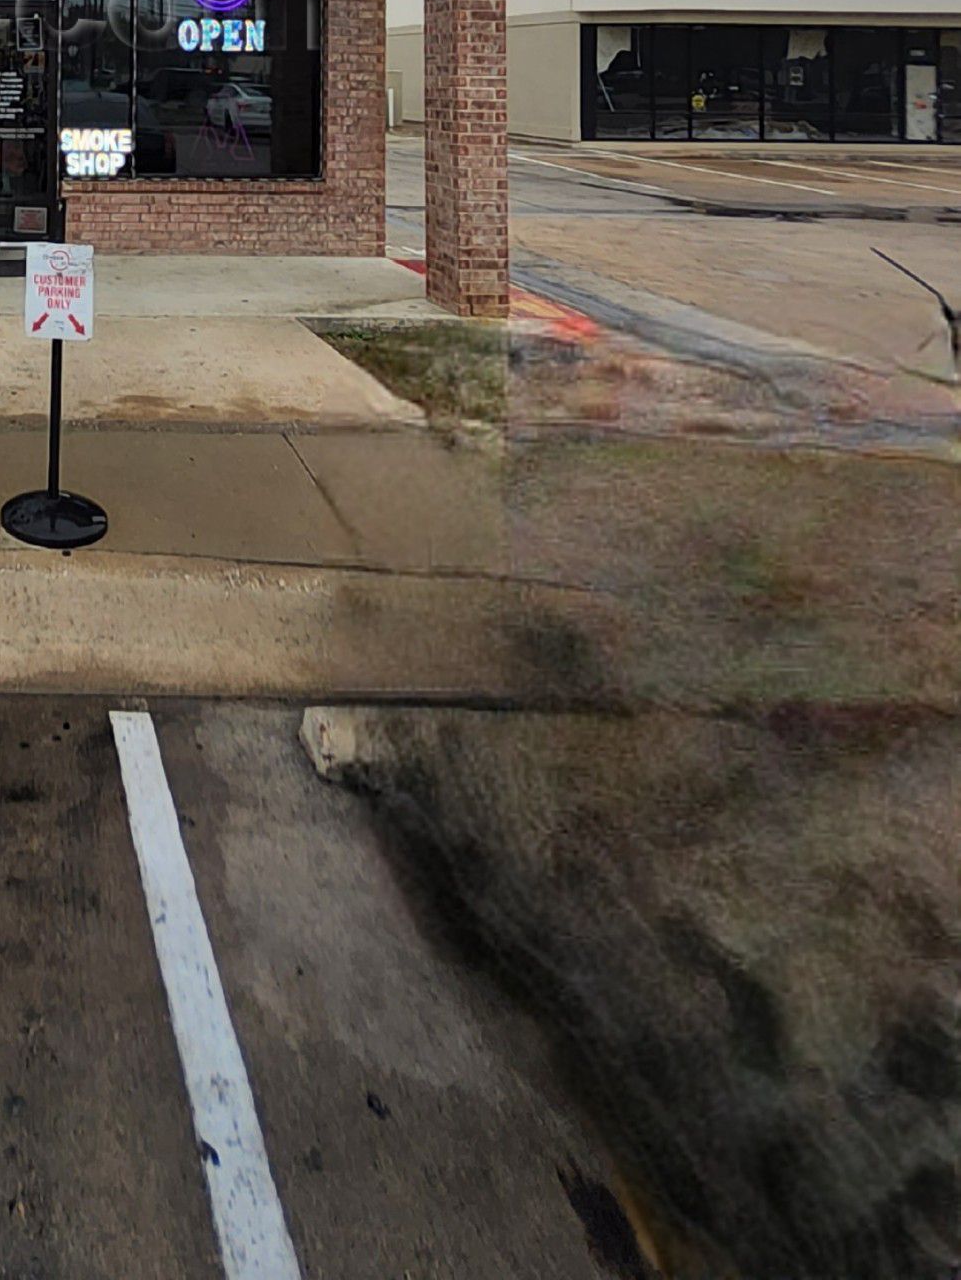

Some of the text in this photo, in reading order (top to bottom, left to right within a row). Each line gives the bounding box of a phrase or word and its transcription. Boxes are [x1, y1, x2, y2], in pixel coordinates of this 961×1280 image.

[178, 19, 265, 52] OPEN
[60, 128, 132, 152] SMOKE
[66, 152, 126, 176] SHOP
[34, 274, 86, 287] CUSTOMER
[38, 285, 80, 299] PARKING
[47, 297, 71, 310] ONLY
